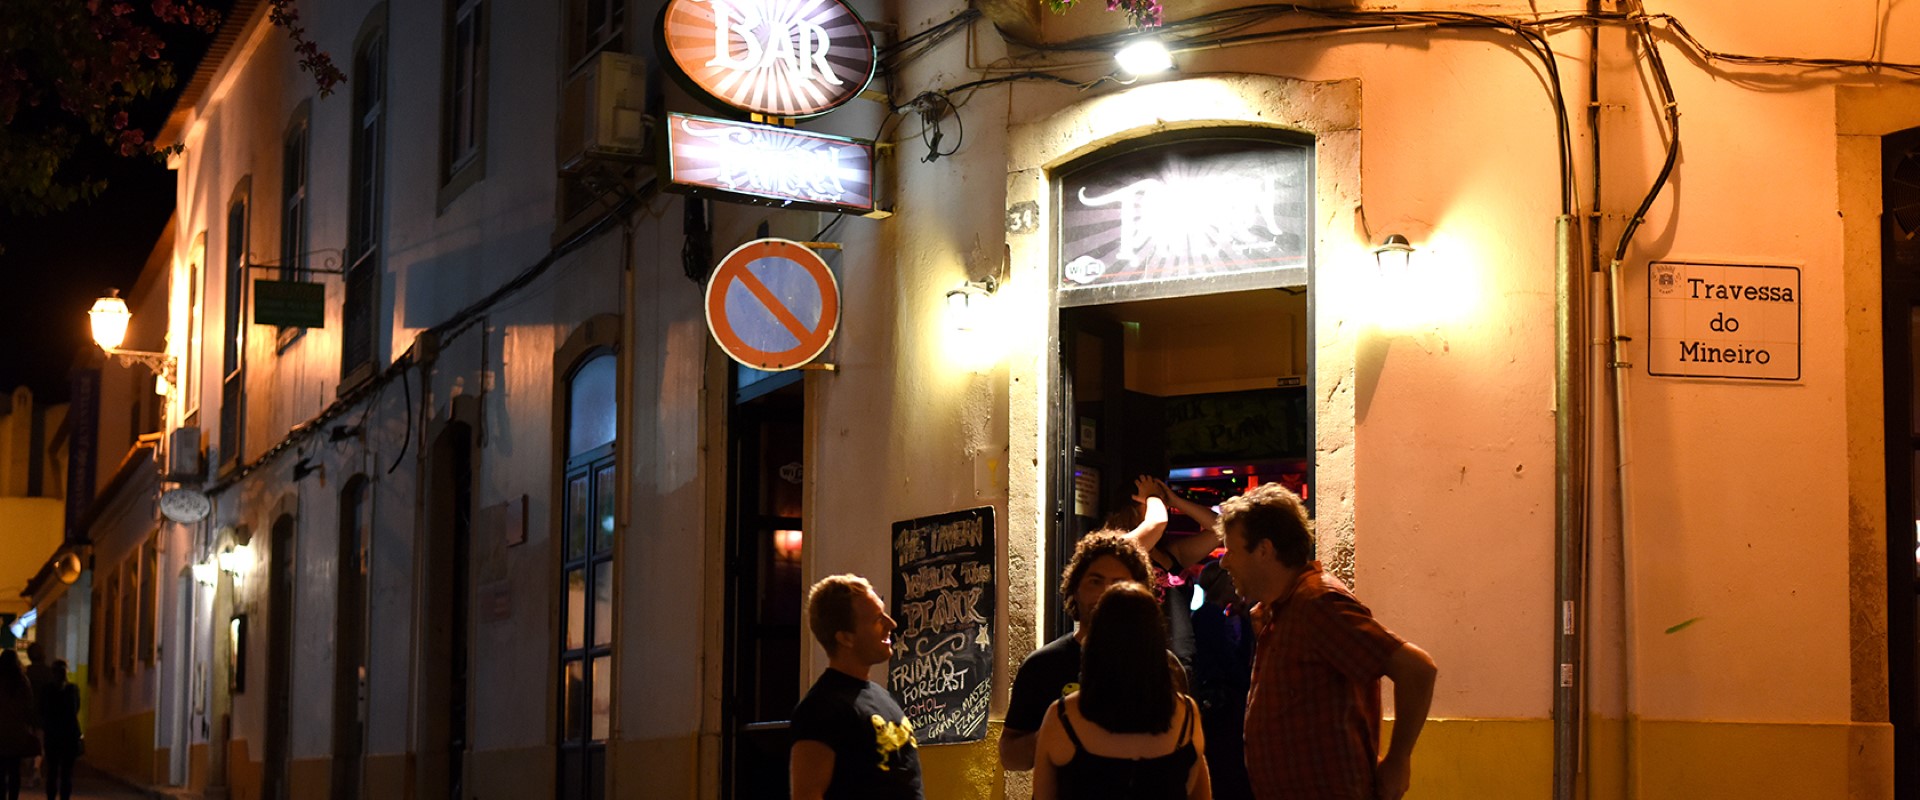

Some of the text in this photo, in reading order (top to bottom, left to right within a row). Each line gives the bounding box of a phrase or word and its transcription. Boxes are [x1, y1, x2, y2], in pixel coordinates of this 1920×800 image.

[705, 0, 843, 86] BAR
[1687, 278, 1794, 303] Travessa
[1710, 312, 1739, 332] do
[1679, 341, 1771, 364] Mineiro
[901, 564, 959, 600] WALK
[901, 587, 988, 637] PLANK
[891, 651, 955, 691] FRIDAYS
[903, 667, 969, 705] FORECAST
[910, 708, 945, 730] NCING
[928, 678, 992, 740] GRAND MASTER
